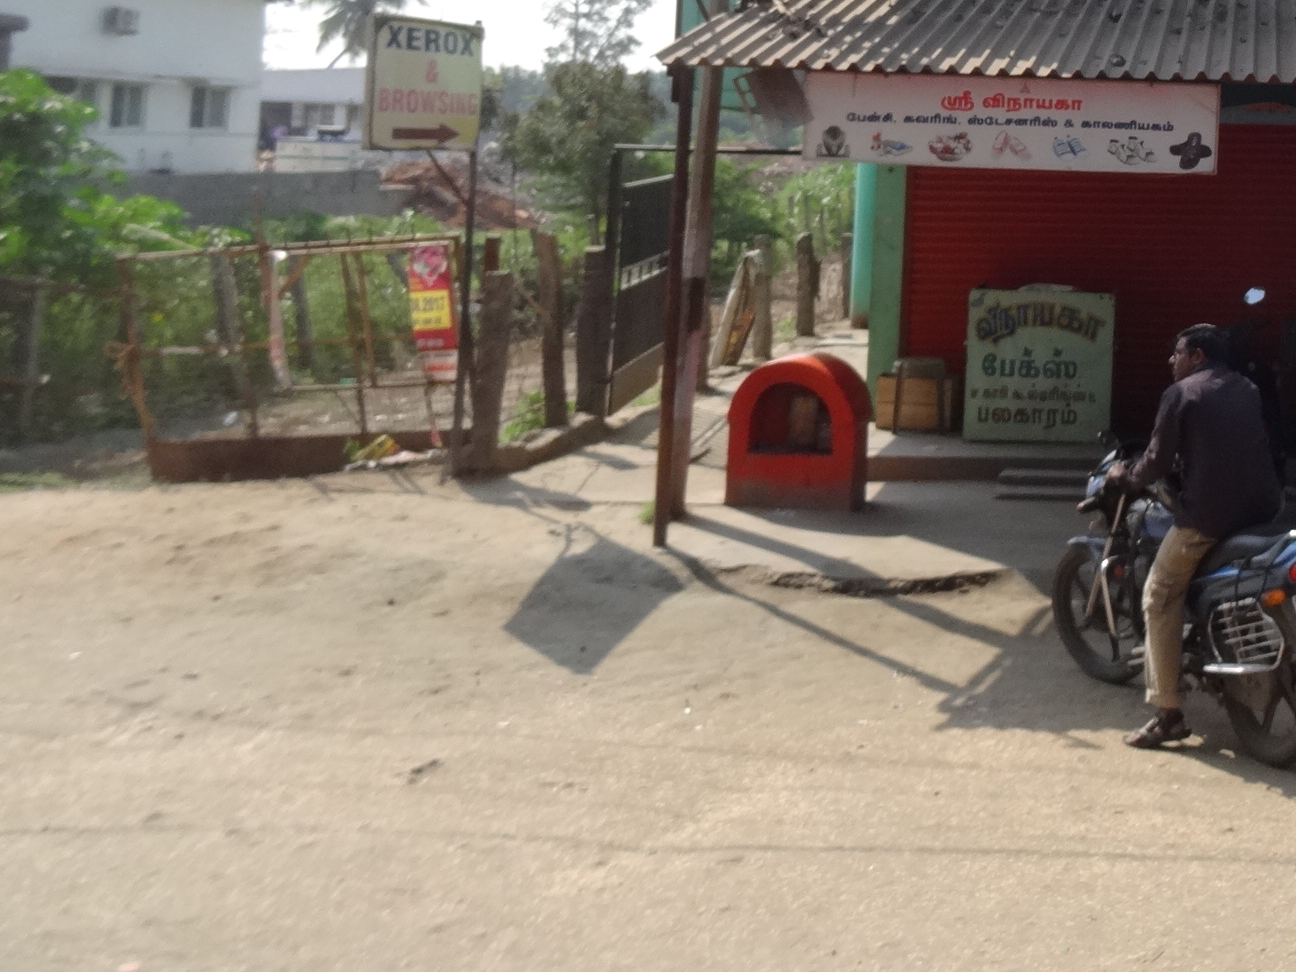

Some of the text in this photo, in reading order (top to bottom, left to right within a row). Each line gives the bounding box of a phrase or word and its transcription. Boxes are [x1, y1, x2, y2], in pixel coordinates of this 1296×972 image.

[386, 25, 474, 57] XEROX
[379, 87, 478, 115] BROWSING
[982, 93, 1083, 113] விநாயகா
[1064, 118, 1074, 129] &
[982, 347, 1078, 379] பேக்ஸ்
